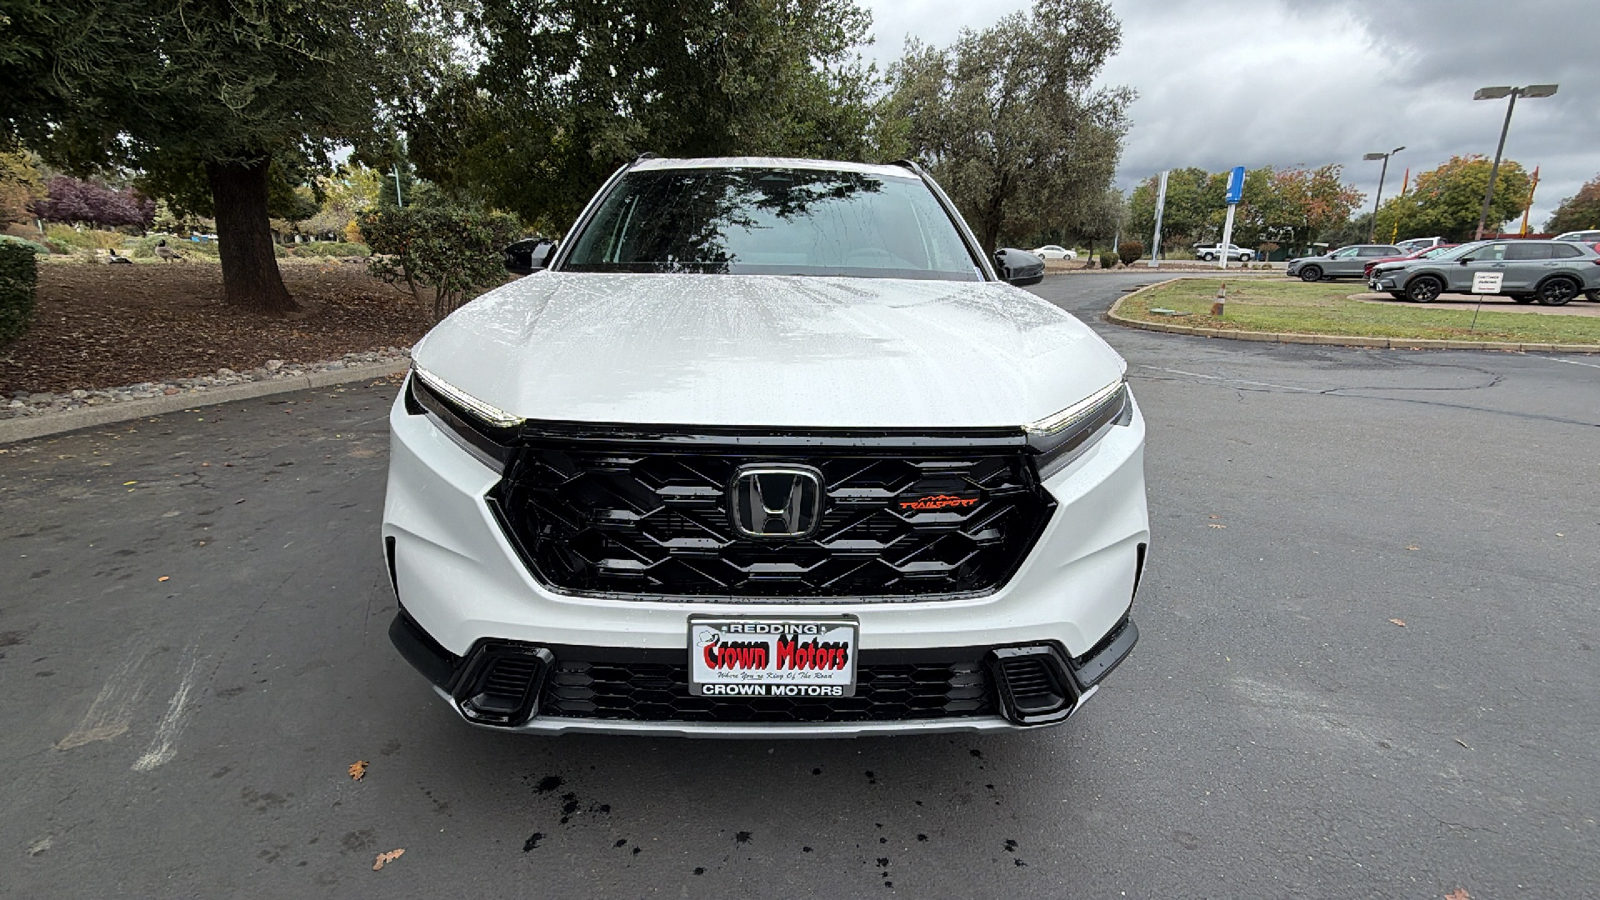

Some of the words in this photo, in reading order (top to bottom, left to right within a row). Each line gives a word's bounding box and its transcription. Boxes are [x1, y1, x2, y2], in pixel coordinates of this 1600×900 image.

[900, 498, 978, 510] TRAILSPORT
[730, 624, 818, 634] REDDING
[703, 638, 769, 671] Crown
[776, 635, 848, 671] Motors
[717, 671, 739, 679] Where
[766, 671, 784, 680] King
[786, 671, 796, 681] Of
[798, 671, 811, 679] The
[702, 684, 766, 695] CROWN
[771, 685, 843, 696] MOTORS
